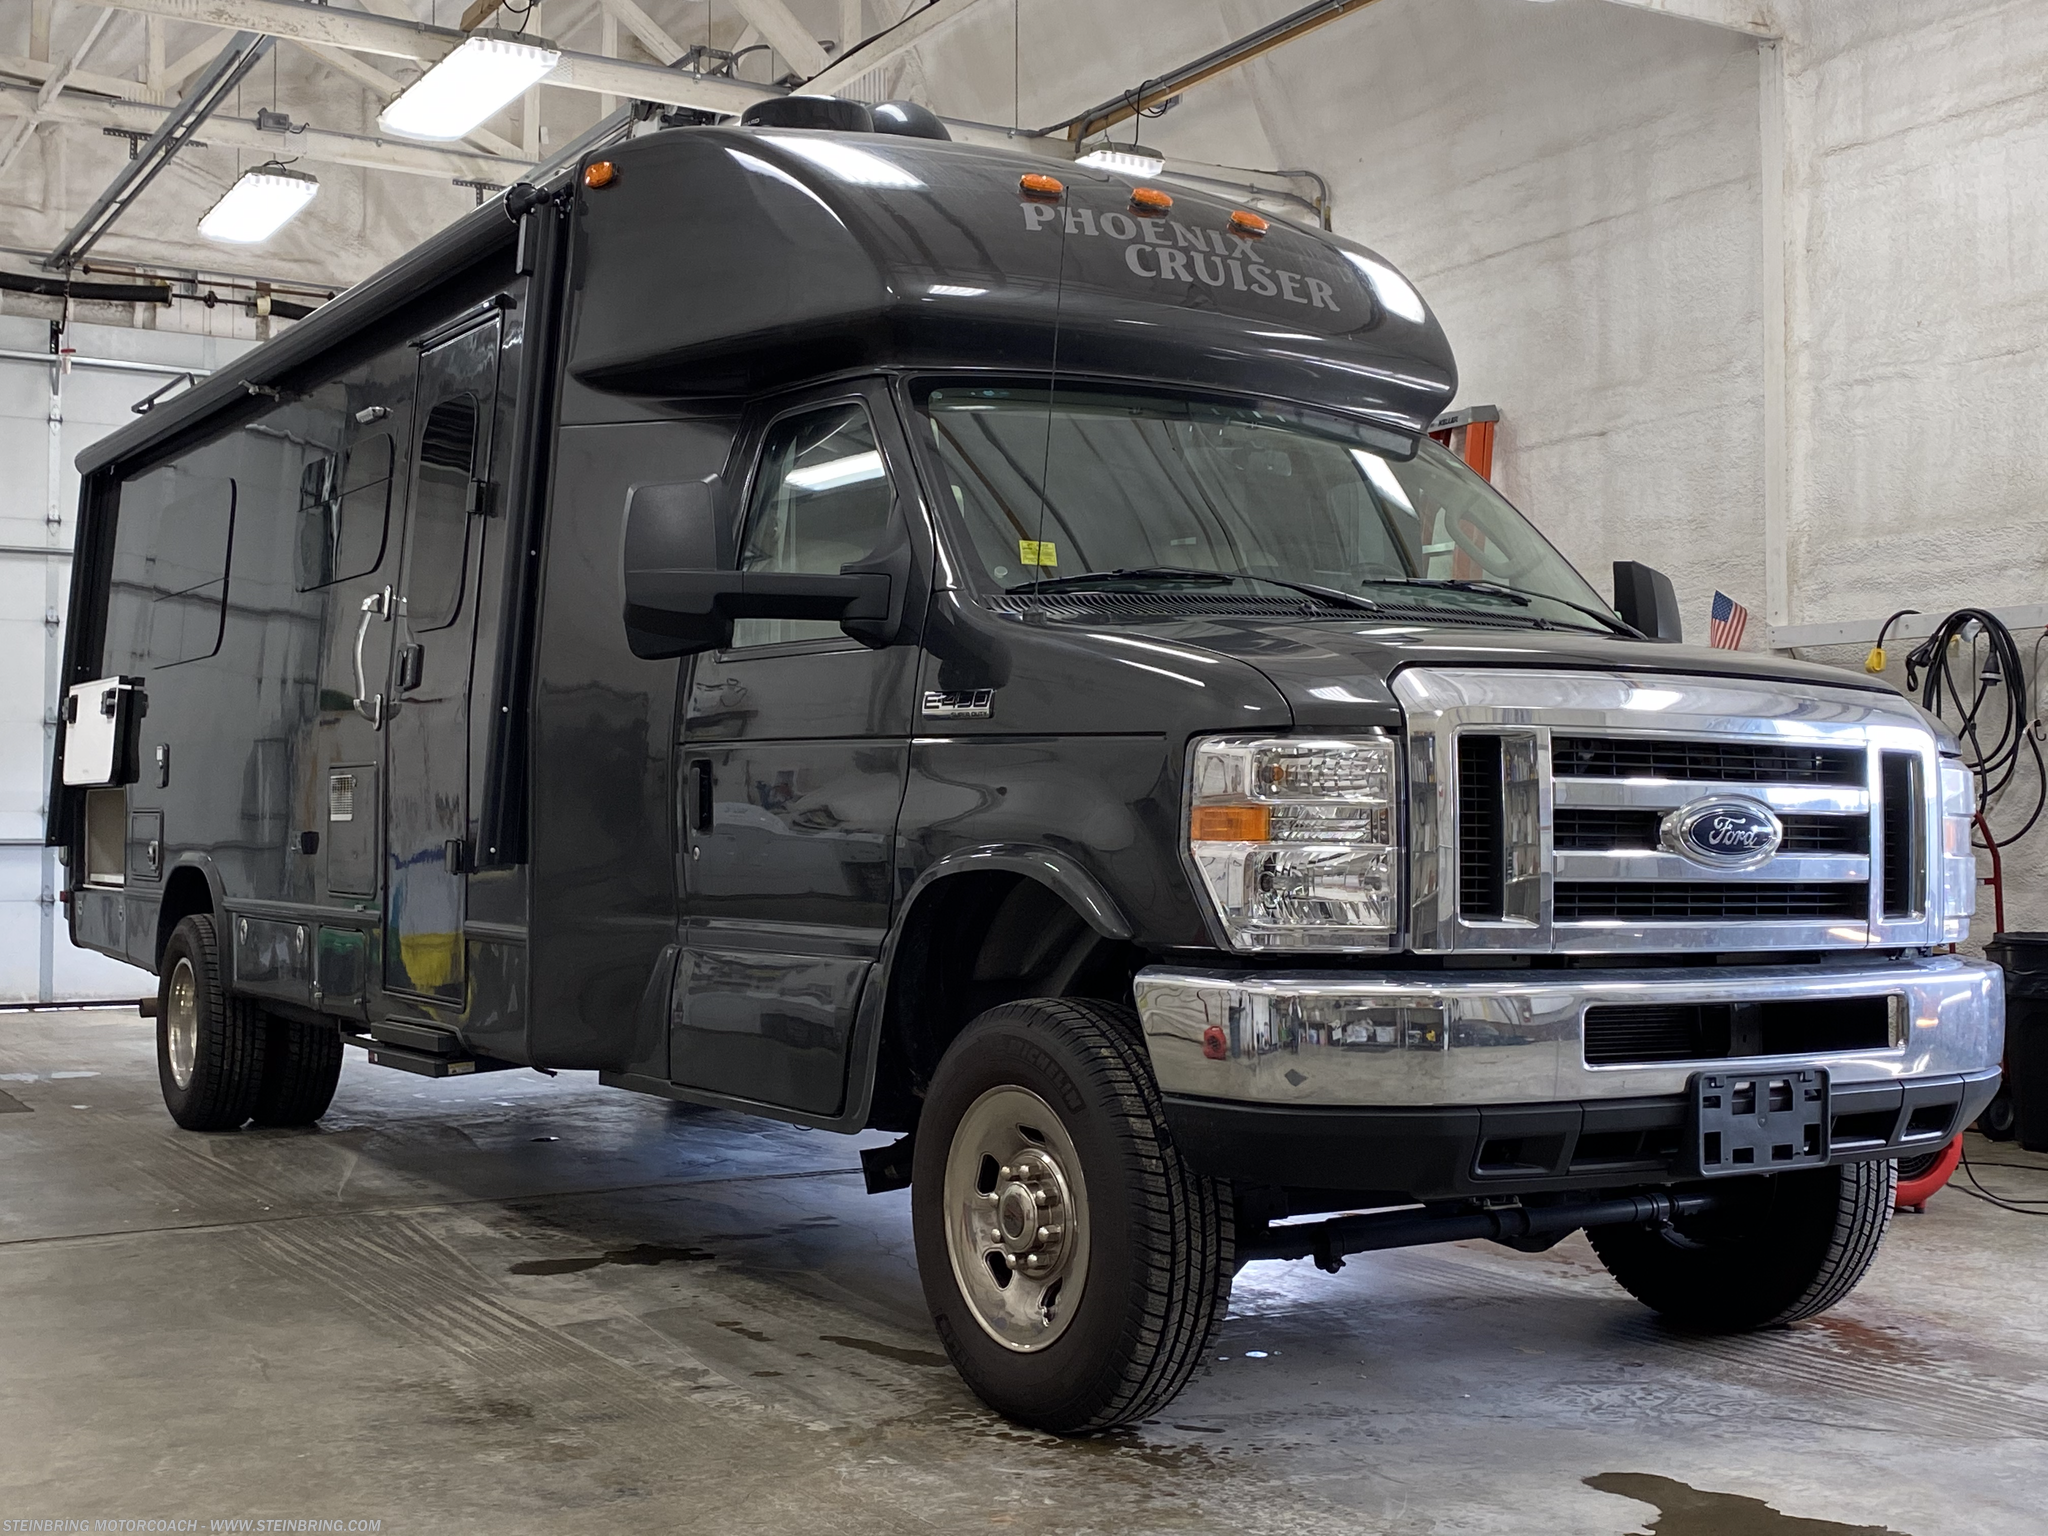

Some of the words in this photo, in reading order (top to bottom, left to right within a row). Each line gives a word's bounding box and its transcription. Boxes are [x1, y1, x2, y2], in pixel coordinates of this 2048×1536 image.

[1020, 202, 1265, 263] PHOENIX
[1124, 244, 1341, 312] CRUISER
[1709, 816, 1758, 848] Ford
